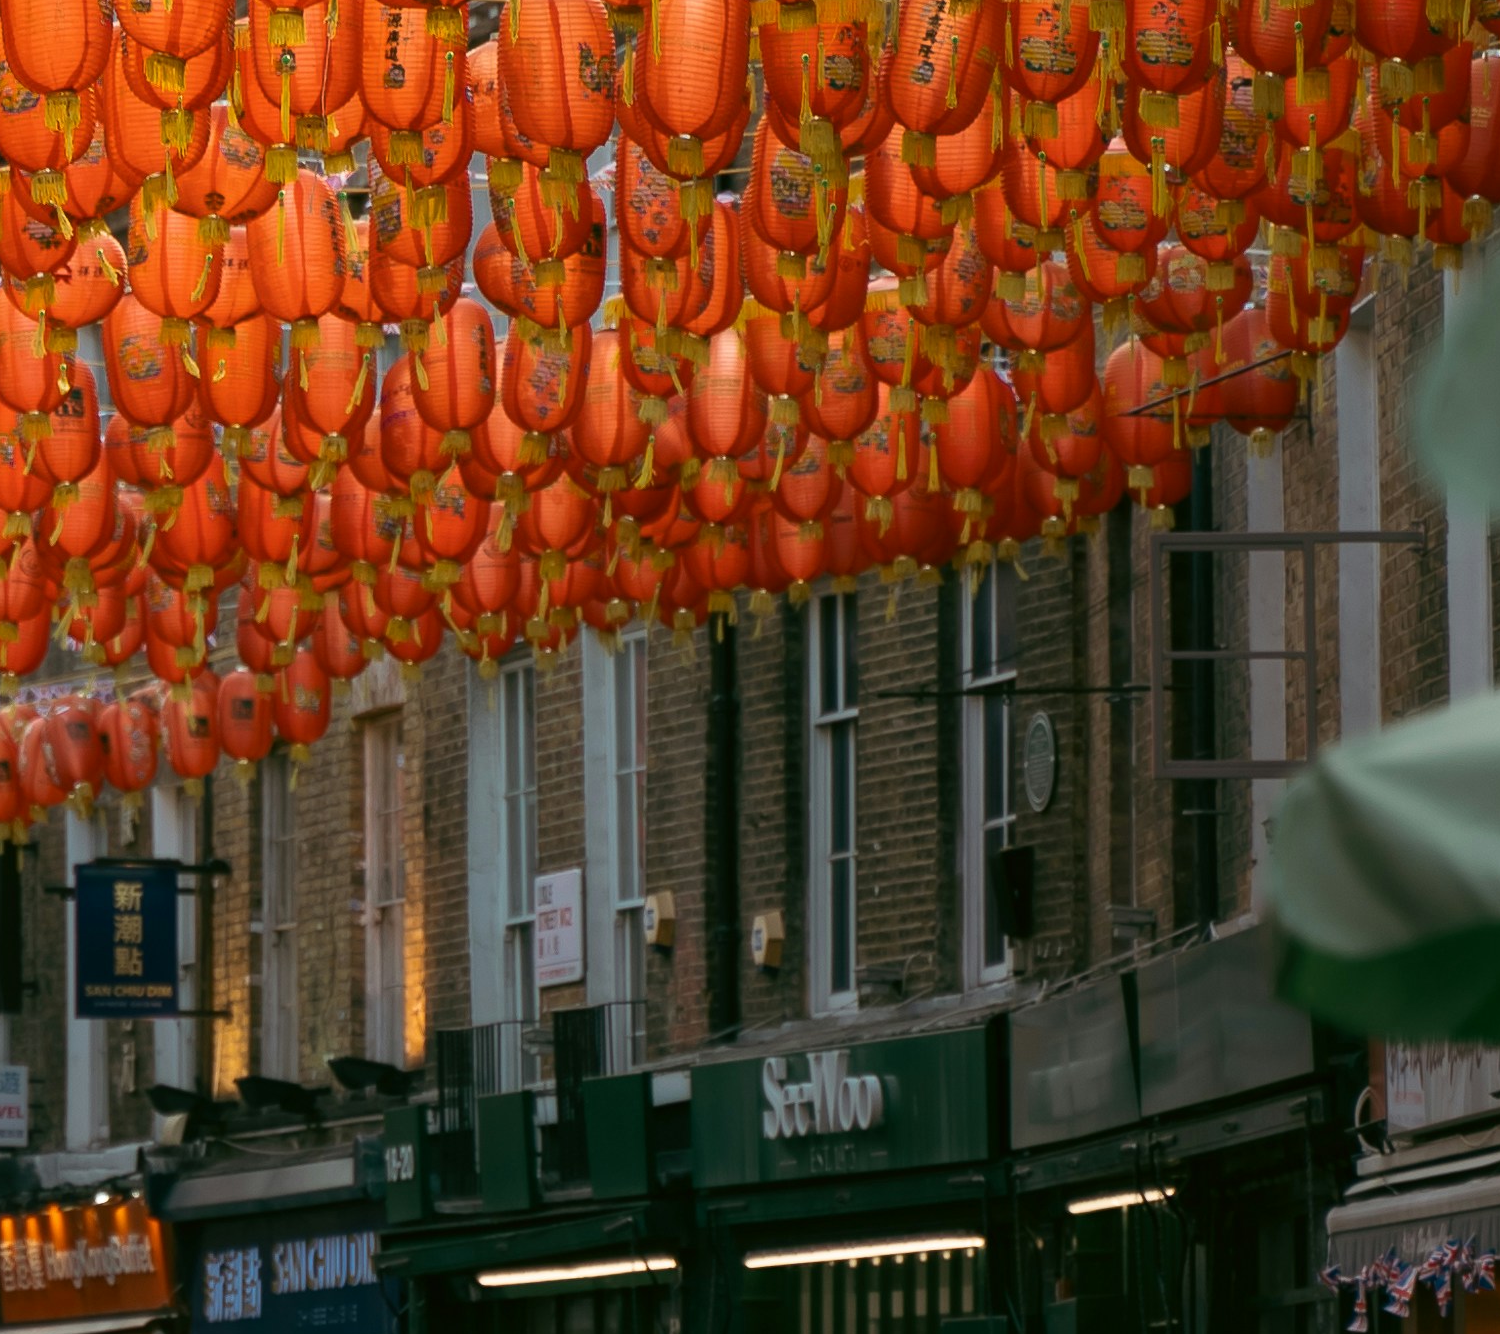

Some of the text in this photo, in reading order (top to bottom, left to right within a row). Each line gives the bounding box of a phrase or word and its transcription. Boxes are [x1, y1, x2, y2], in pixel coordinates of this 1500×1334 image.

[111, 880, 145, 978] 新潮點
[84, 983, 174, 998] SAN CHIU DIM
